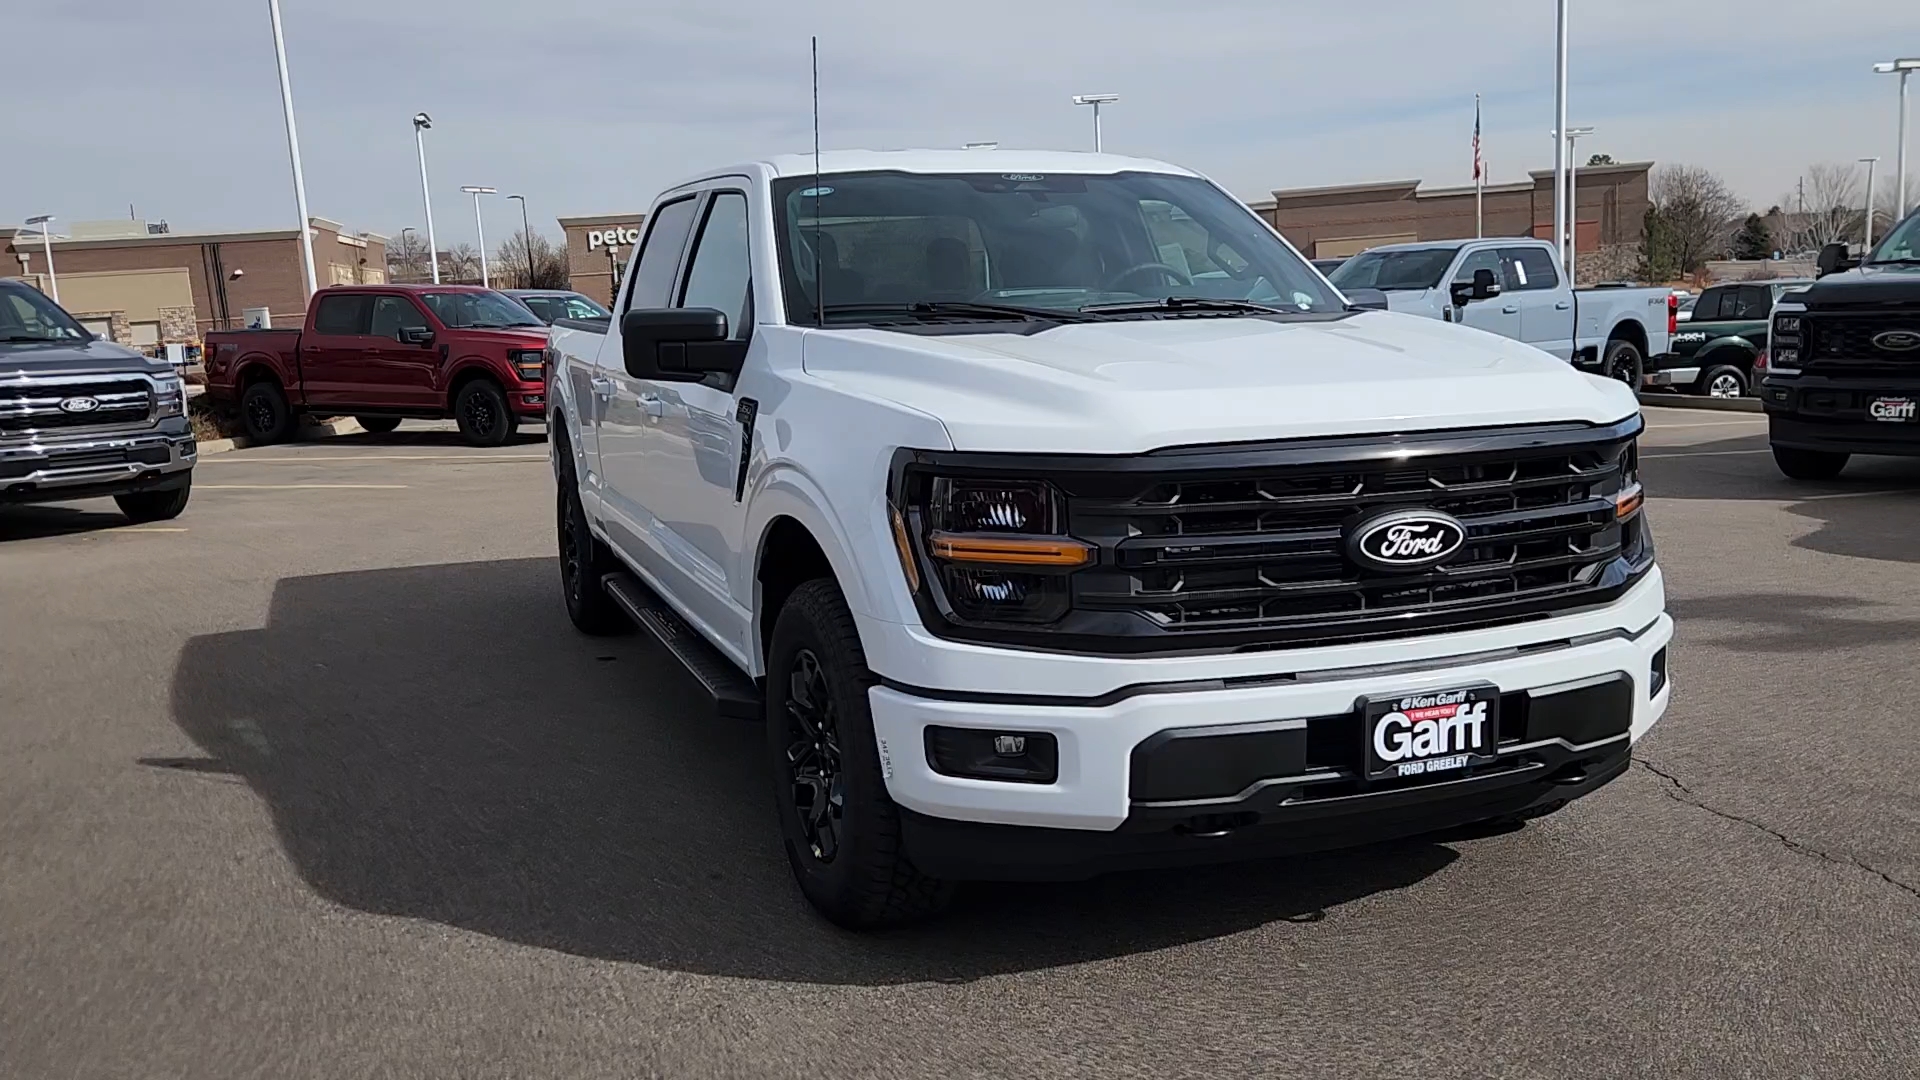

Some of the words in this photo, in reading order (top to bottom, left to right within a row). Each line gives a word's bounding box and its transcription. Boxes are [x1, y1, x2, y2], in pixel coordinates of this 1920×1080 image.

[588, 226, 639, 250] petc
[1870, 401, 1916, 417] Garff
[1381, 524, 1444, 557] Ford
[1411, 696, 1435, 708] Ken
[1436, 690, 1467, 705] Garff
[1373, 701, 1487, 761] Garff
[1398, 763, 1424, 776] FORD
[1426, 755, 1469, 772] GREELEY
